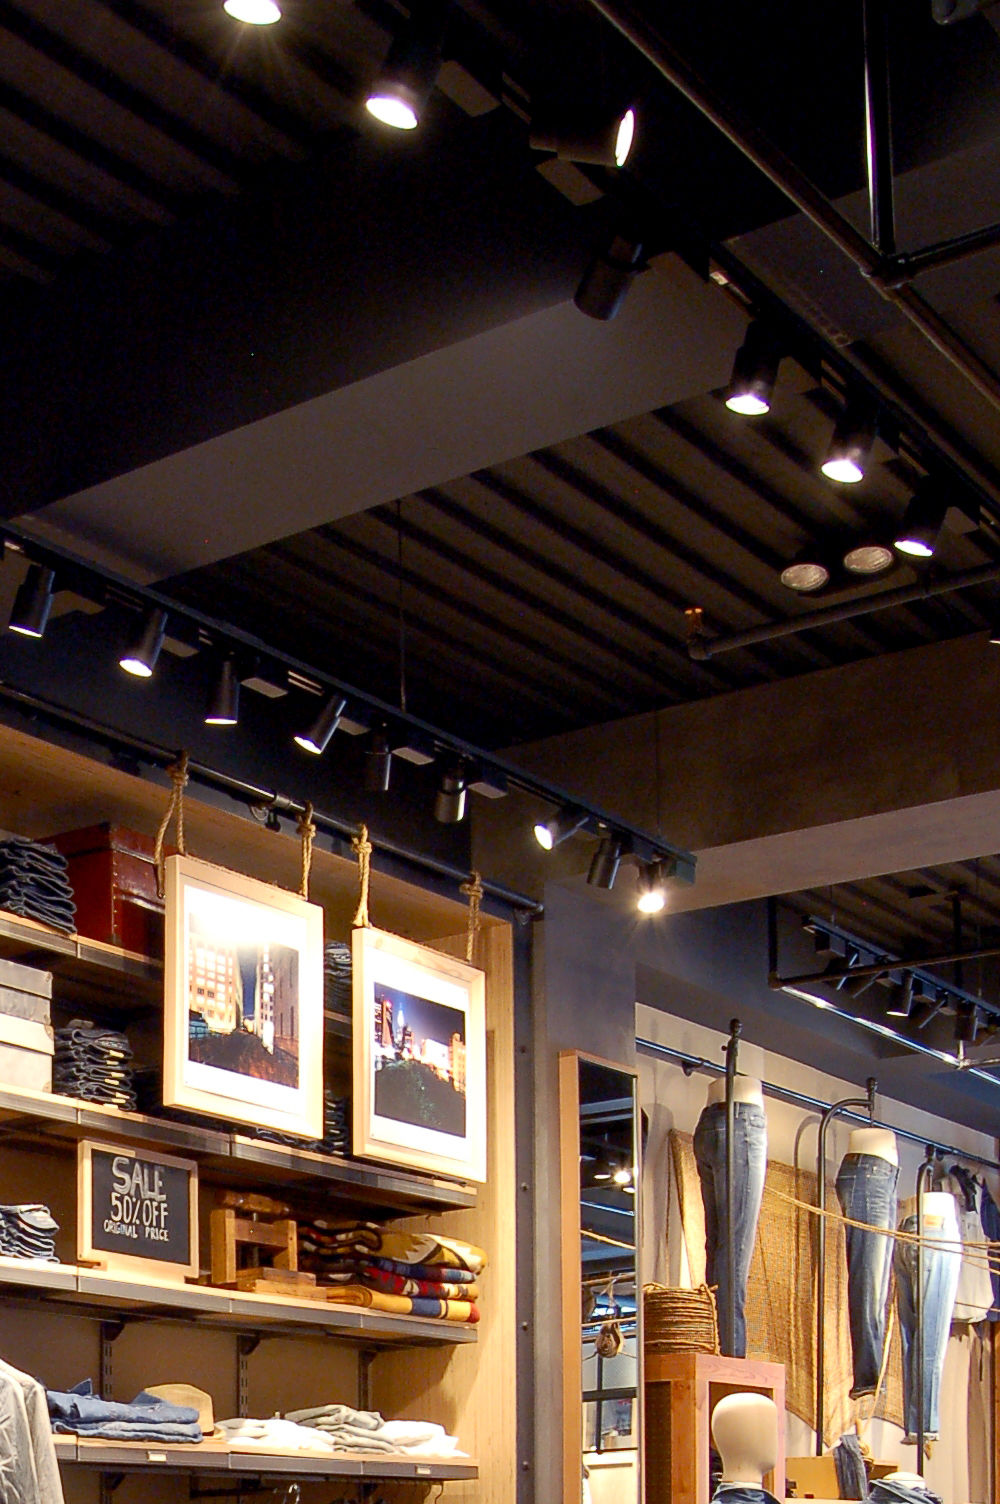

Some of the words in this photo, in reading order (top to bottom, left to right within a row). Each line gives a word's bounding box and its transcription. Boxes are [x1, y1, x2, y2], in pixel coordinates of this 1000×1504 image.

[112, 1156, 167, 1201] SALE
[110, 1191, 141, 1226] 50%
[142, 1200, 169, 1228] OFF
[103, 1219, 139, 1239] ORIGINAL
[145, 1226, 170, 1242] PRICE
